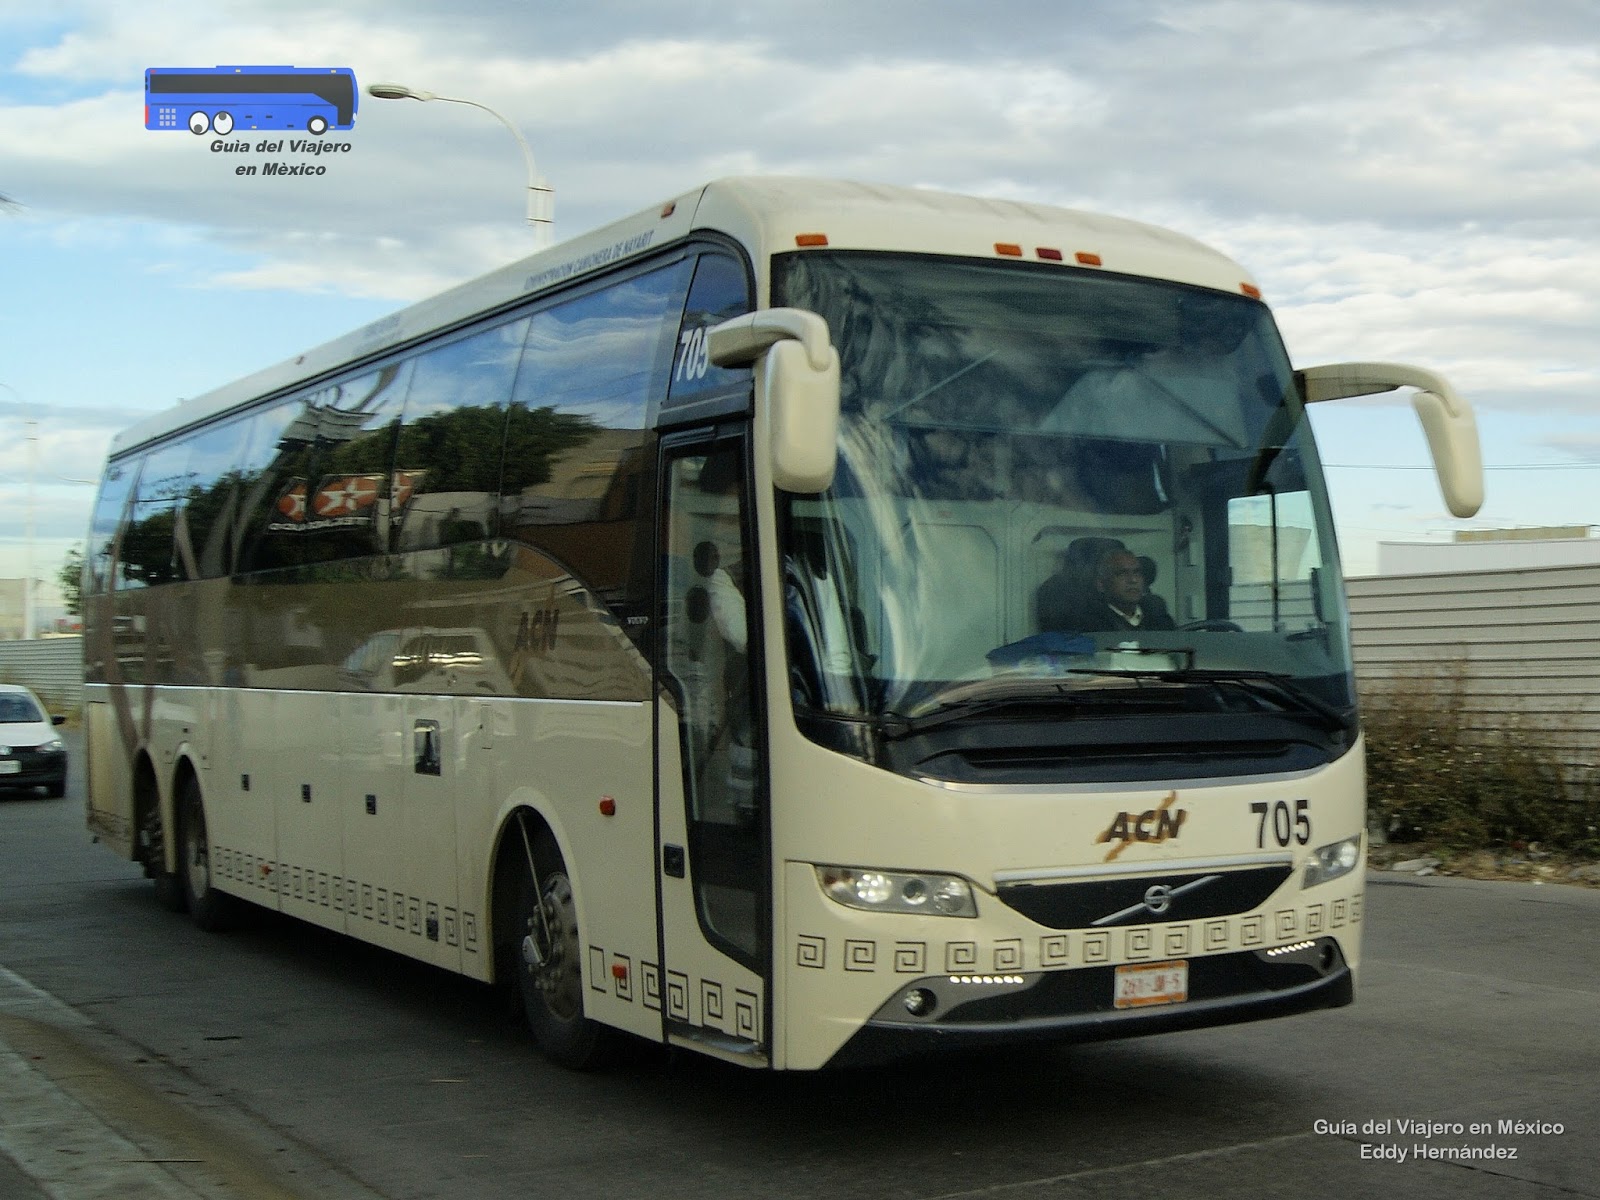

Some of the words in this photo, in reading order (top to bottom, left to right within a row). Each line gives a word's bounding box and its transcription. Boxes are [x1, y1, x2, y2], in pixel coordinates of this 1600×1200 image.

[621, 229, 655, 254] NAYARIT
[676, 325, 709, 382] 705
[514, 608, 560, 651] ACN
[1101, 808, 1185, 843] ACN
[1250, 799, 1311, 849] 705
